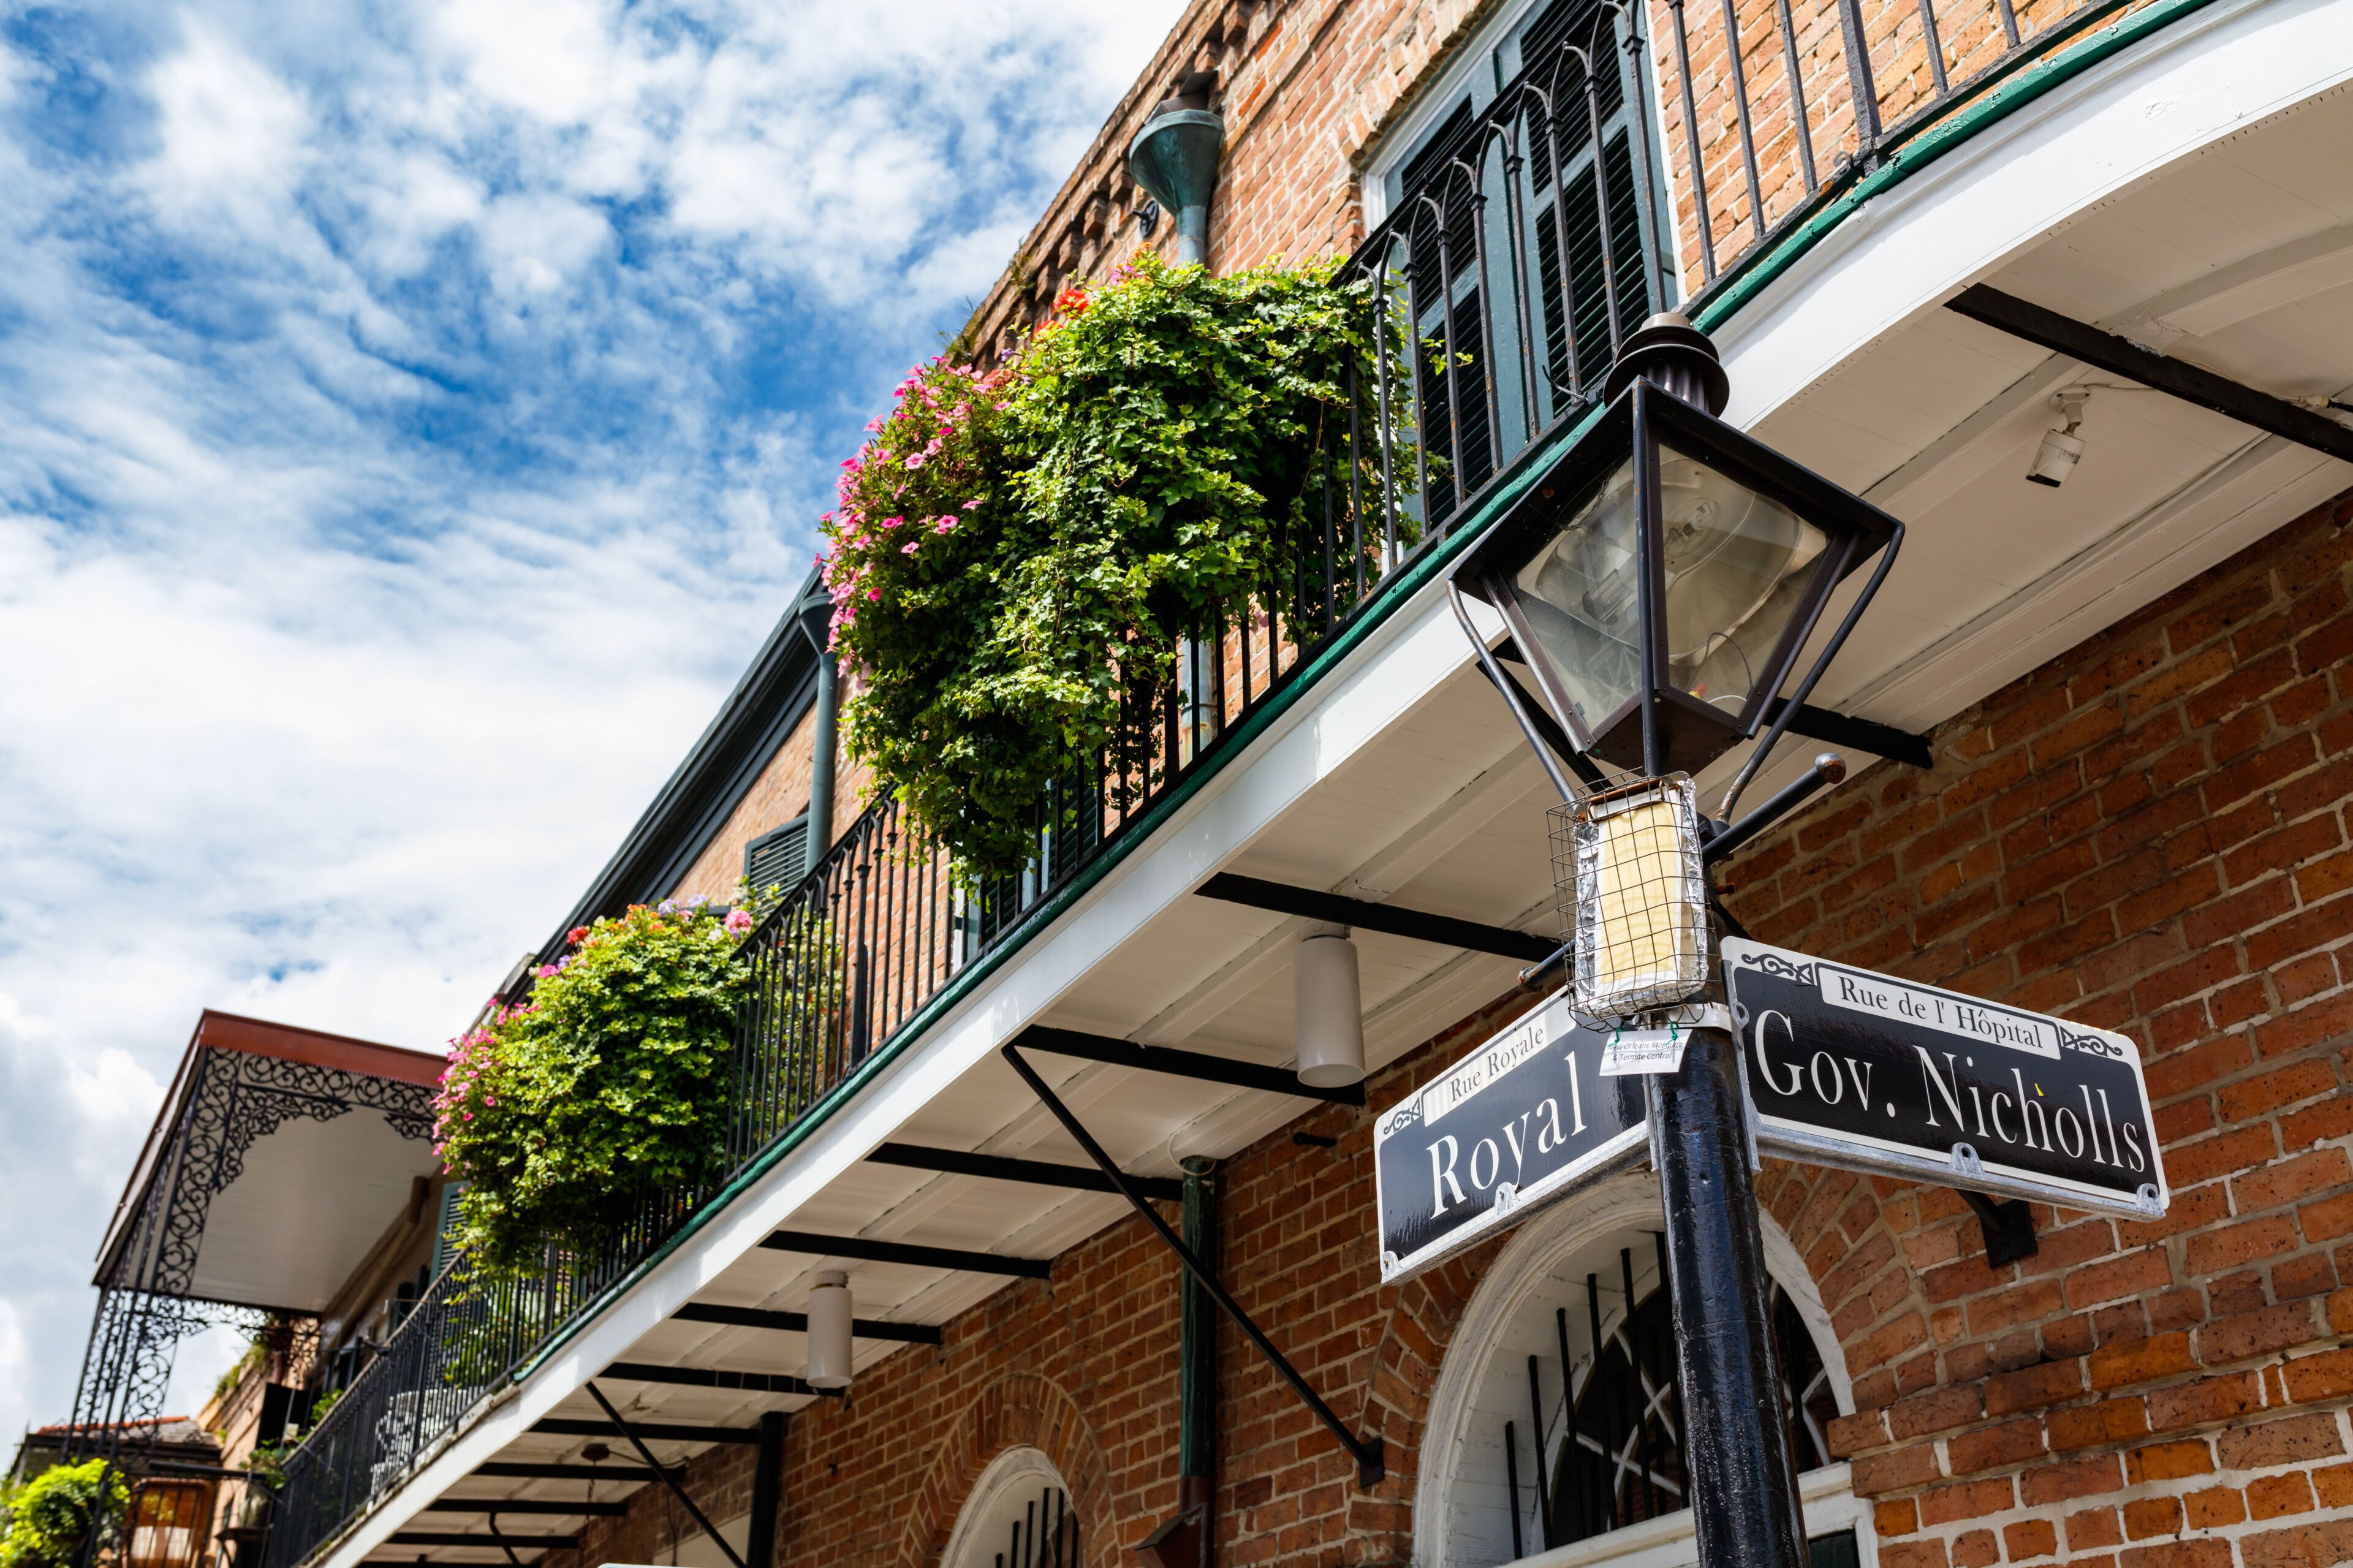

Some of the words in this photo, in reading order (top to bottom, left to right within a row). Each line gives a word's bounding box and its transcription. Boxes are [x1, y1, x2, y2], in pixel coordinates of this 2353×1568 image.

[1651, 1041, 1683, 1051] Mosquito
[1838, 975, 1889, 1010] Rue
[1899, 991, 1927, 1018] de
[1954, 1005, 2044, 1048] Hôpital
[1450, 1069, 1482, 1103] Rue
[1487, 1026, 1544, 1078] Royale
[1754, 1010, 1896, 1118] Gov.
[1913, 1045, 2145, 1173] Nicholls
[1426, 1051, 1587, 1220] Royal
